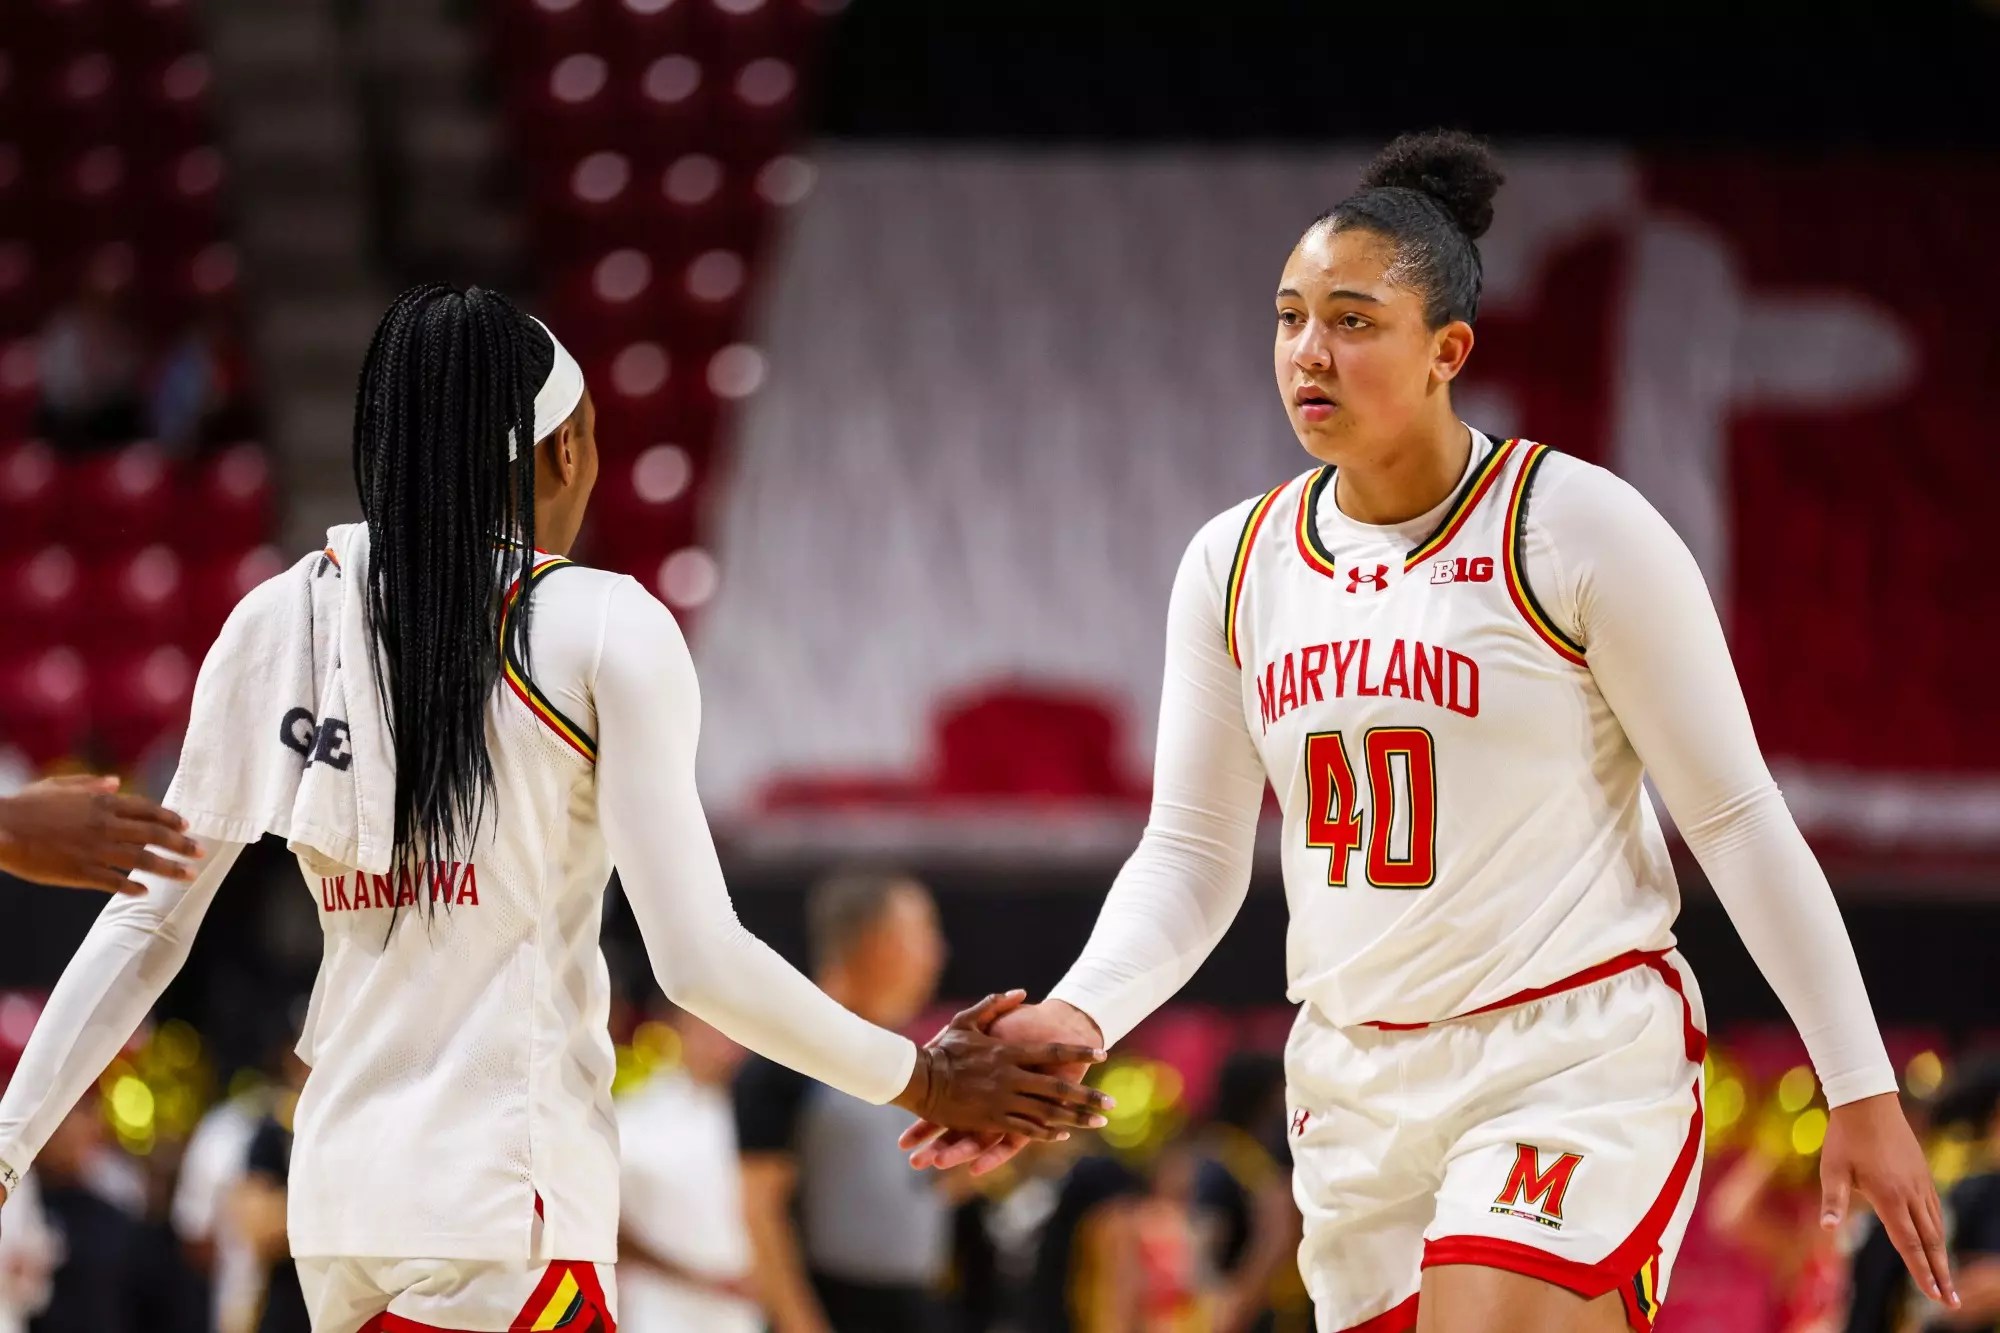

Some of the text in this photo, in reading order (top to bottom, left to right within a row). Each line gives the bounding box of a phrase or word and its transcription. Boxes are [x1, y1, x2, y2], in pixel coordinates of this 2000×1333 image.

[1257, 638, 1479, 736] MARYLAND
[1305, 726, 1437, 889] 40
[1494, 1143, 1584, 1220] M
